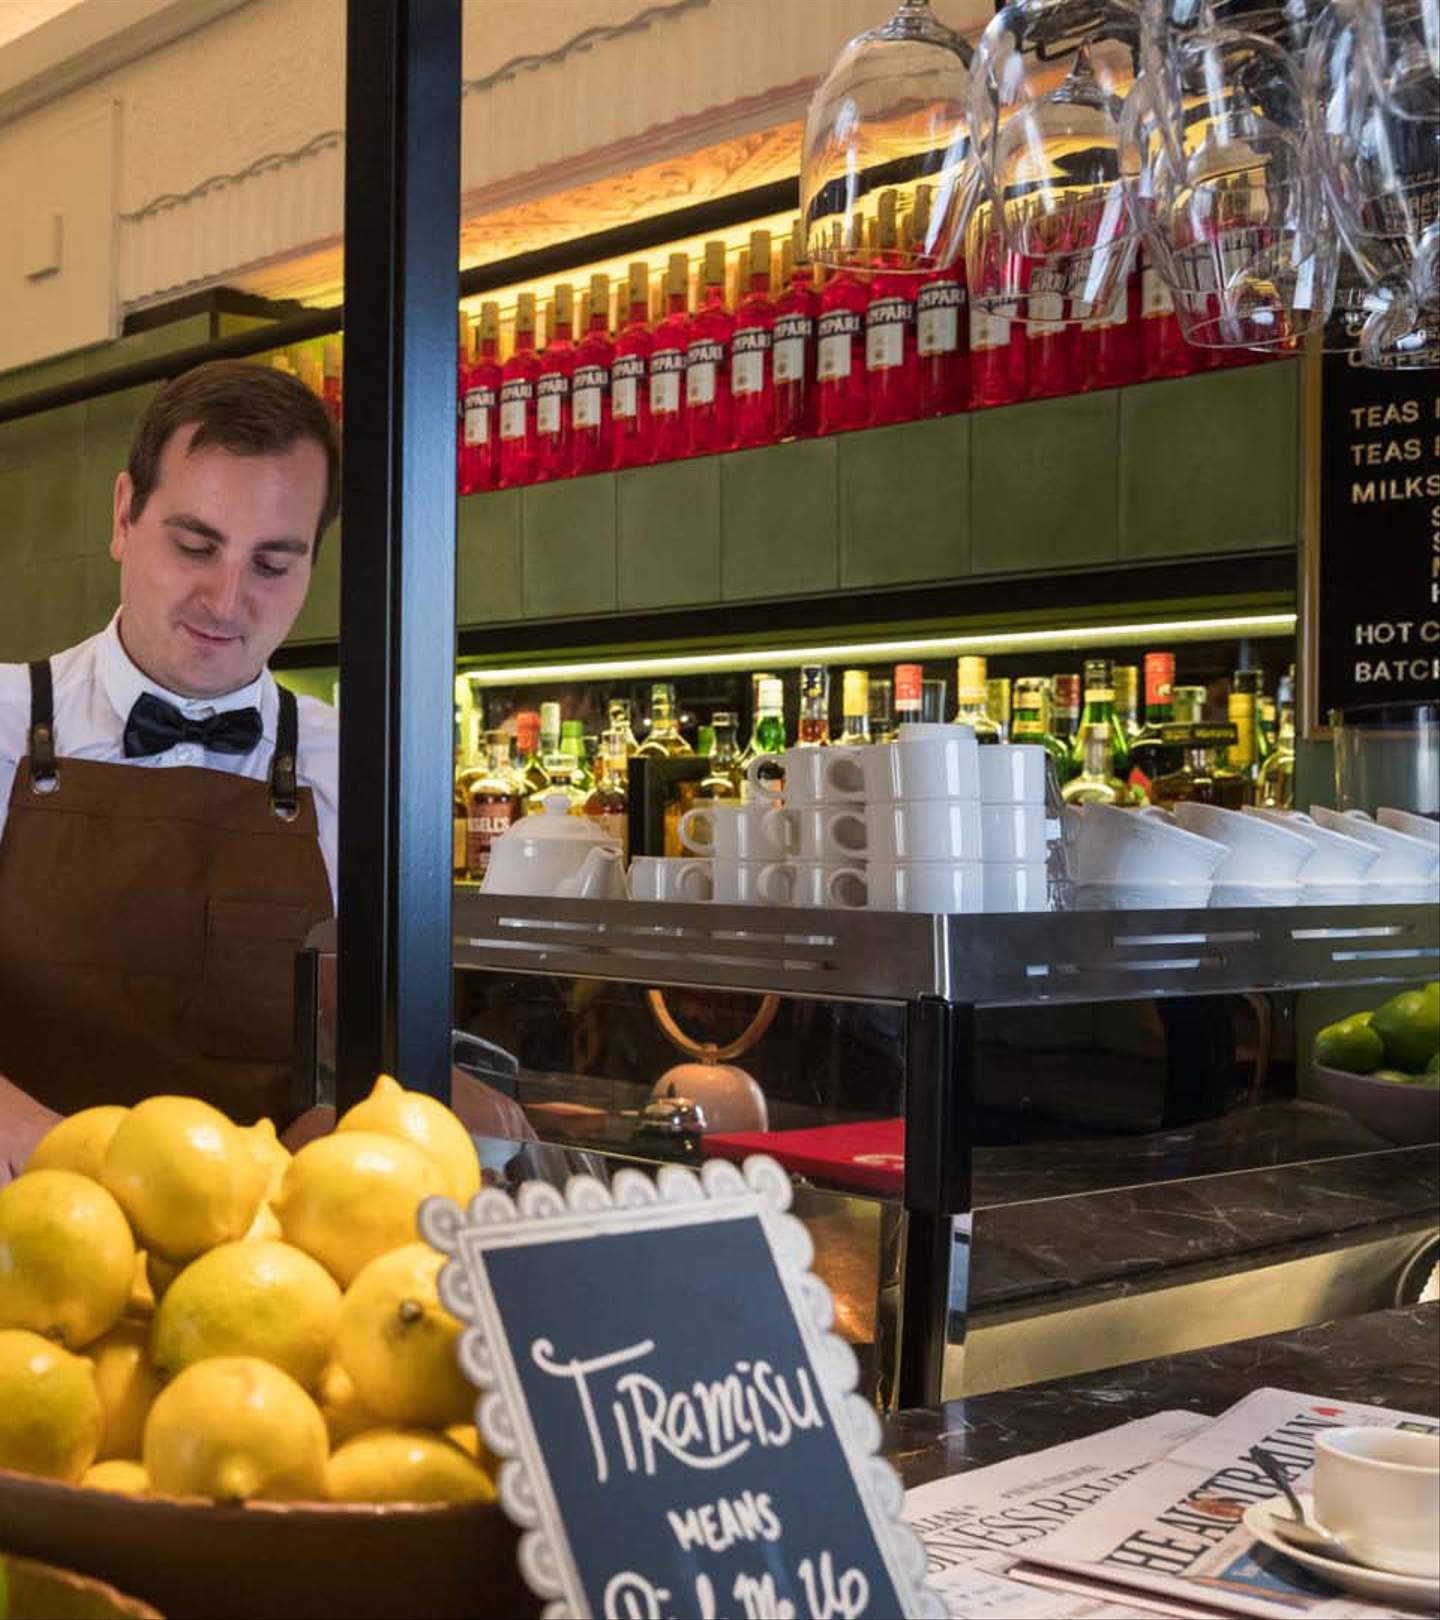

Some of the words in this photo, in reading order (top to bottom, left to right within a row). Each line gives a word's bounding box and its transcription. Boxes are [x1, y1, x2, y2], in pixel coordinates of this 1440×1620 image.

[1350, 400, 1419, 430] TEAS
[1350, 438, 1422, 466] TEAS
[1355, 621, 1413, 645] HOT
[667, 1490, 782, 1552] MEANS
[1103, 1529, 1212, 1576] HE
